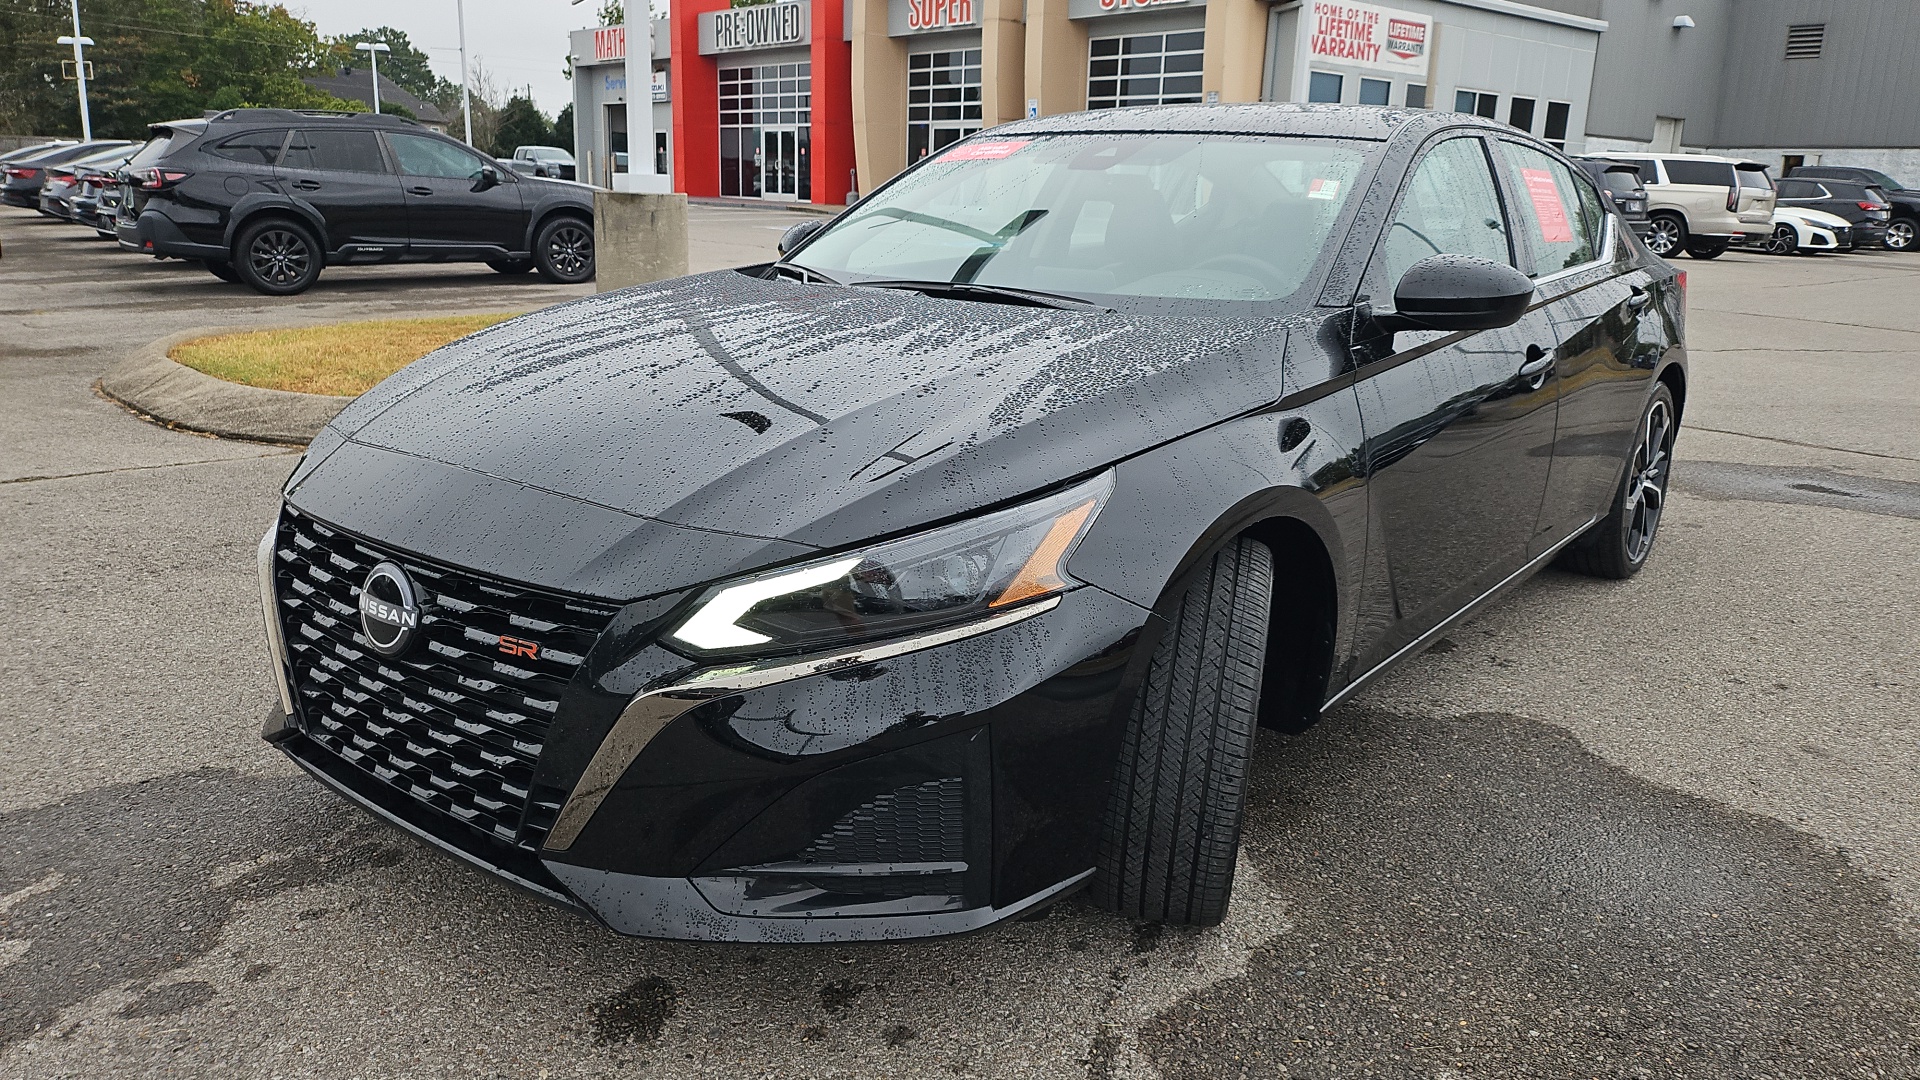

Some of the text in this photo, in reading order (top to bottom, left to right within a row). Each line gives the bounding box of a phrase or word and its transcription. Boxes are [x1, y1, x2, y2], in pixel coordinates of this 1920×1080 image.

[715, 4, 801, 48] PRE-OWNED
[908, 0, 972, 29] SUPER
[1314, 2, 1379, 24] HOME OF THE
[1318, 16, 1373, 42] LIFETIME
[1389, 21, 1424, 40] LIFETIME
[1387, 39, 1423, 55] WARRANTY
[605, 75, 626, 91] Servi
[360, 593, 416, 626] NISSAN
[499, 634, 539, 661] SR
